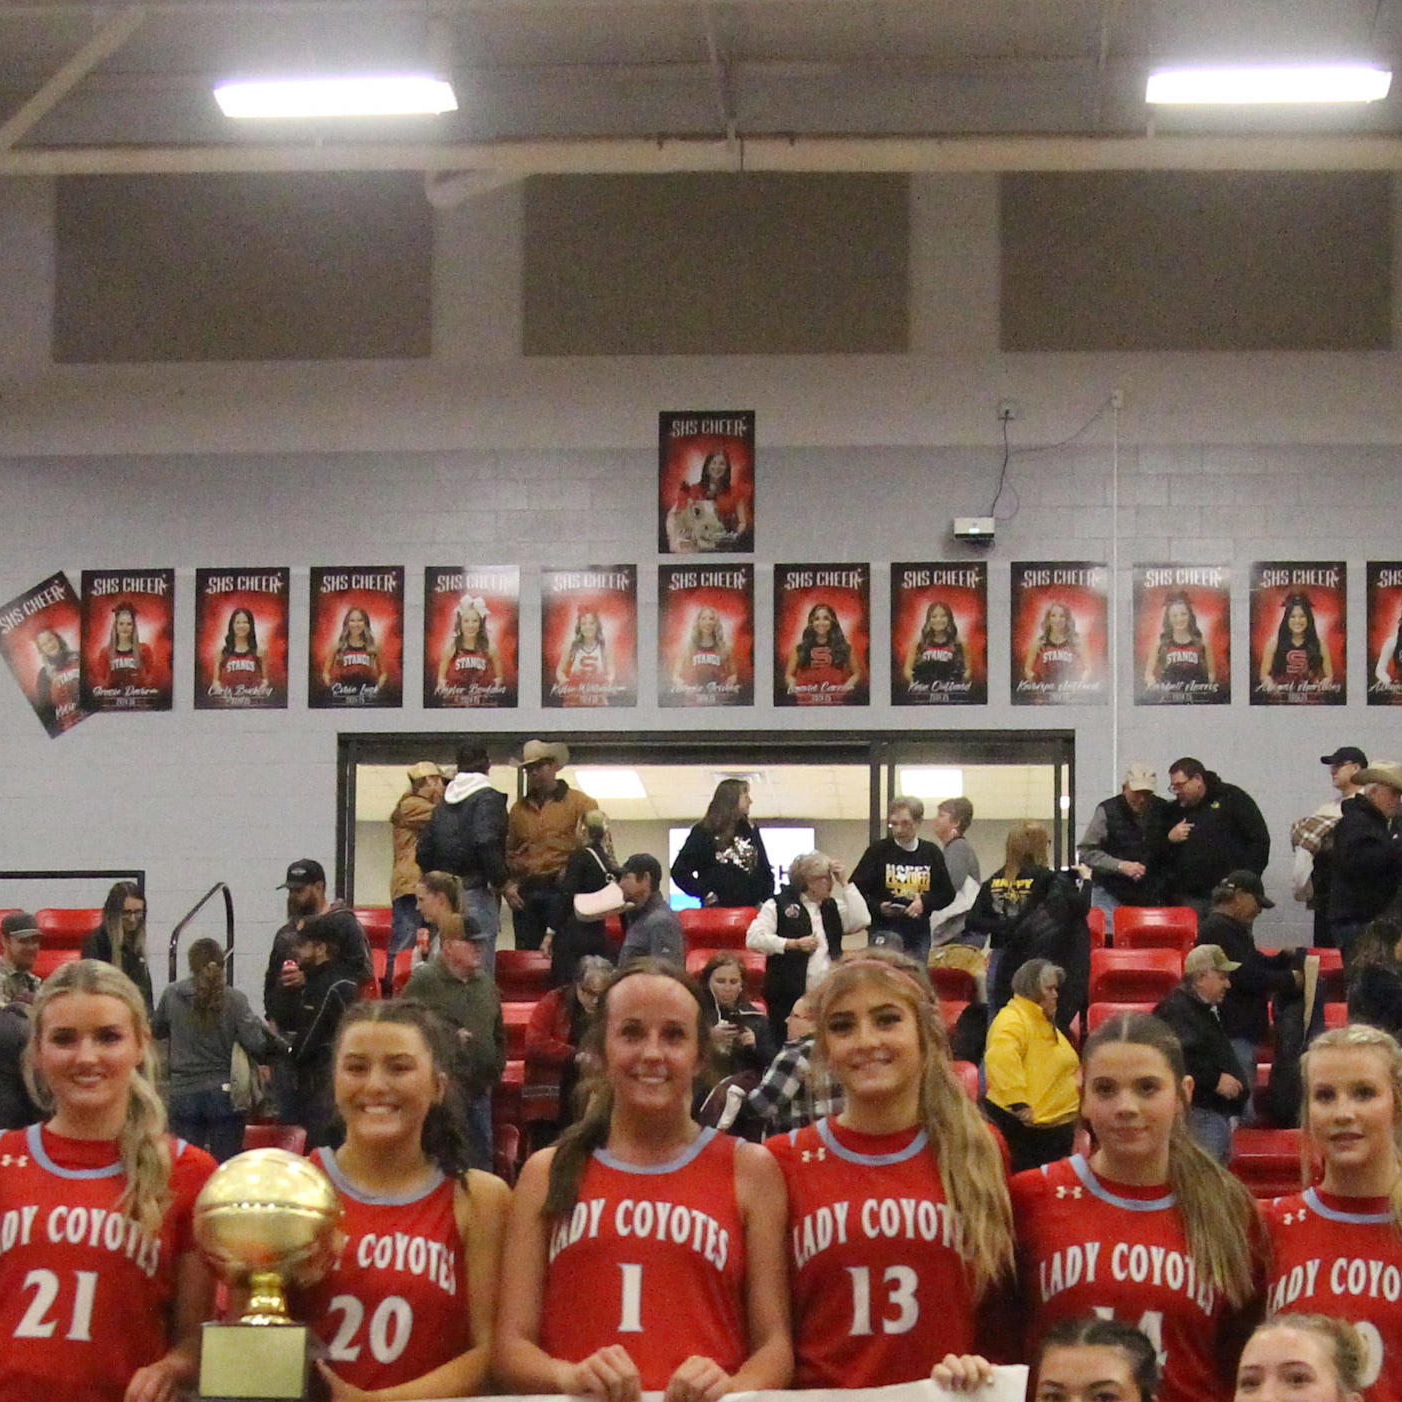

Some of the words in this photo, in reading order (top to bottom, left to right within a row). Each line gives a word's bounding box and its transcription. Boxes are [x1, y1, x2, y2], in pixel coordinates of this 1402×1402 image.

[671, 420, 697, 437] SHS
[702, 419, 744, 438] CHEER
[92, 578, 118, 596] SHS
[123, 577, 164, 596] CHEER
[206, 577, 233, 594] SHS
[237, 575, 279, 594] CHEER
[320, 575, 348, 593] SHS
[352, 574, 393, 593] CHEER
[435, 575, 463, 593] SHS
[554, 572, 578, 592] SHS
[669, 572, 697, 591] SHS
[701, 572, 743, 590] CHEER
[784, 572, 813, 590] SHS
[817, 571, 859, 590] CHEER
[902, 571, 931, 589] SHS
[934, 570, 976, 588] CHEER
[1021, 570, 1051, 588] SHS
[1054, 570, 1096, 588] CHEER
[1144, 570, 1172, 588] SHS
[1177, 569, 1219, 588] CHEER
[1260, 570, 1289, 588] SHS
[1293, 570, 1336, 588] CHEER
[0, 608, 23, 635] SHS
[23, 585, 62, 616] CHEER
[226, 659, 255, 672] STANGS
[455, 657, 486, 671] STANGS
[1043, 651, 1073, 663] STANGS
[1166, 651, 1199, 664] STANGS
[1286, 650, 1309, 673] S
[991, 878, 1034, 889] HAPY
[47, 1205, 162, 1279] COYOTES
[548, 1198, 602, 1264] LADY
[614, 1199, 729, 1272] COYOTES
[793, 1200, 849, 1267] LADY
[1040, 1243, 1099, 1302] LADY
[13, 1269, 97, 1341] 21
[617, 1262, 643, 1333] 1
[846, 1265, 919, 1335] 13
[328, 1295, 413, 1364] 20
